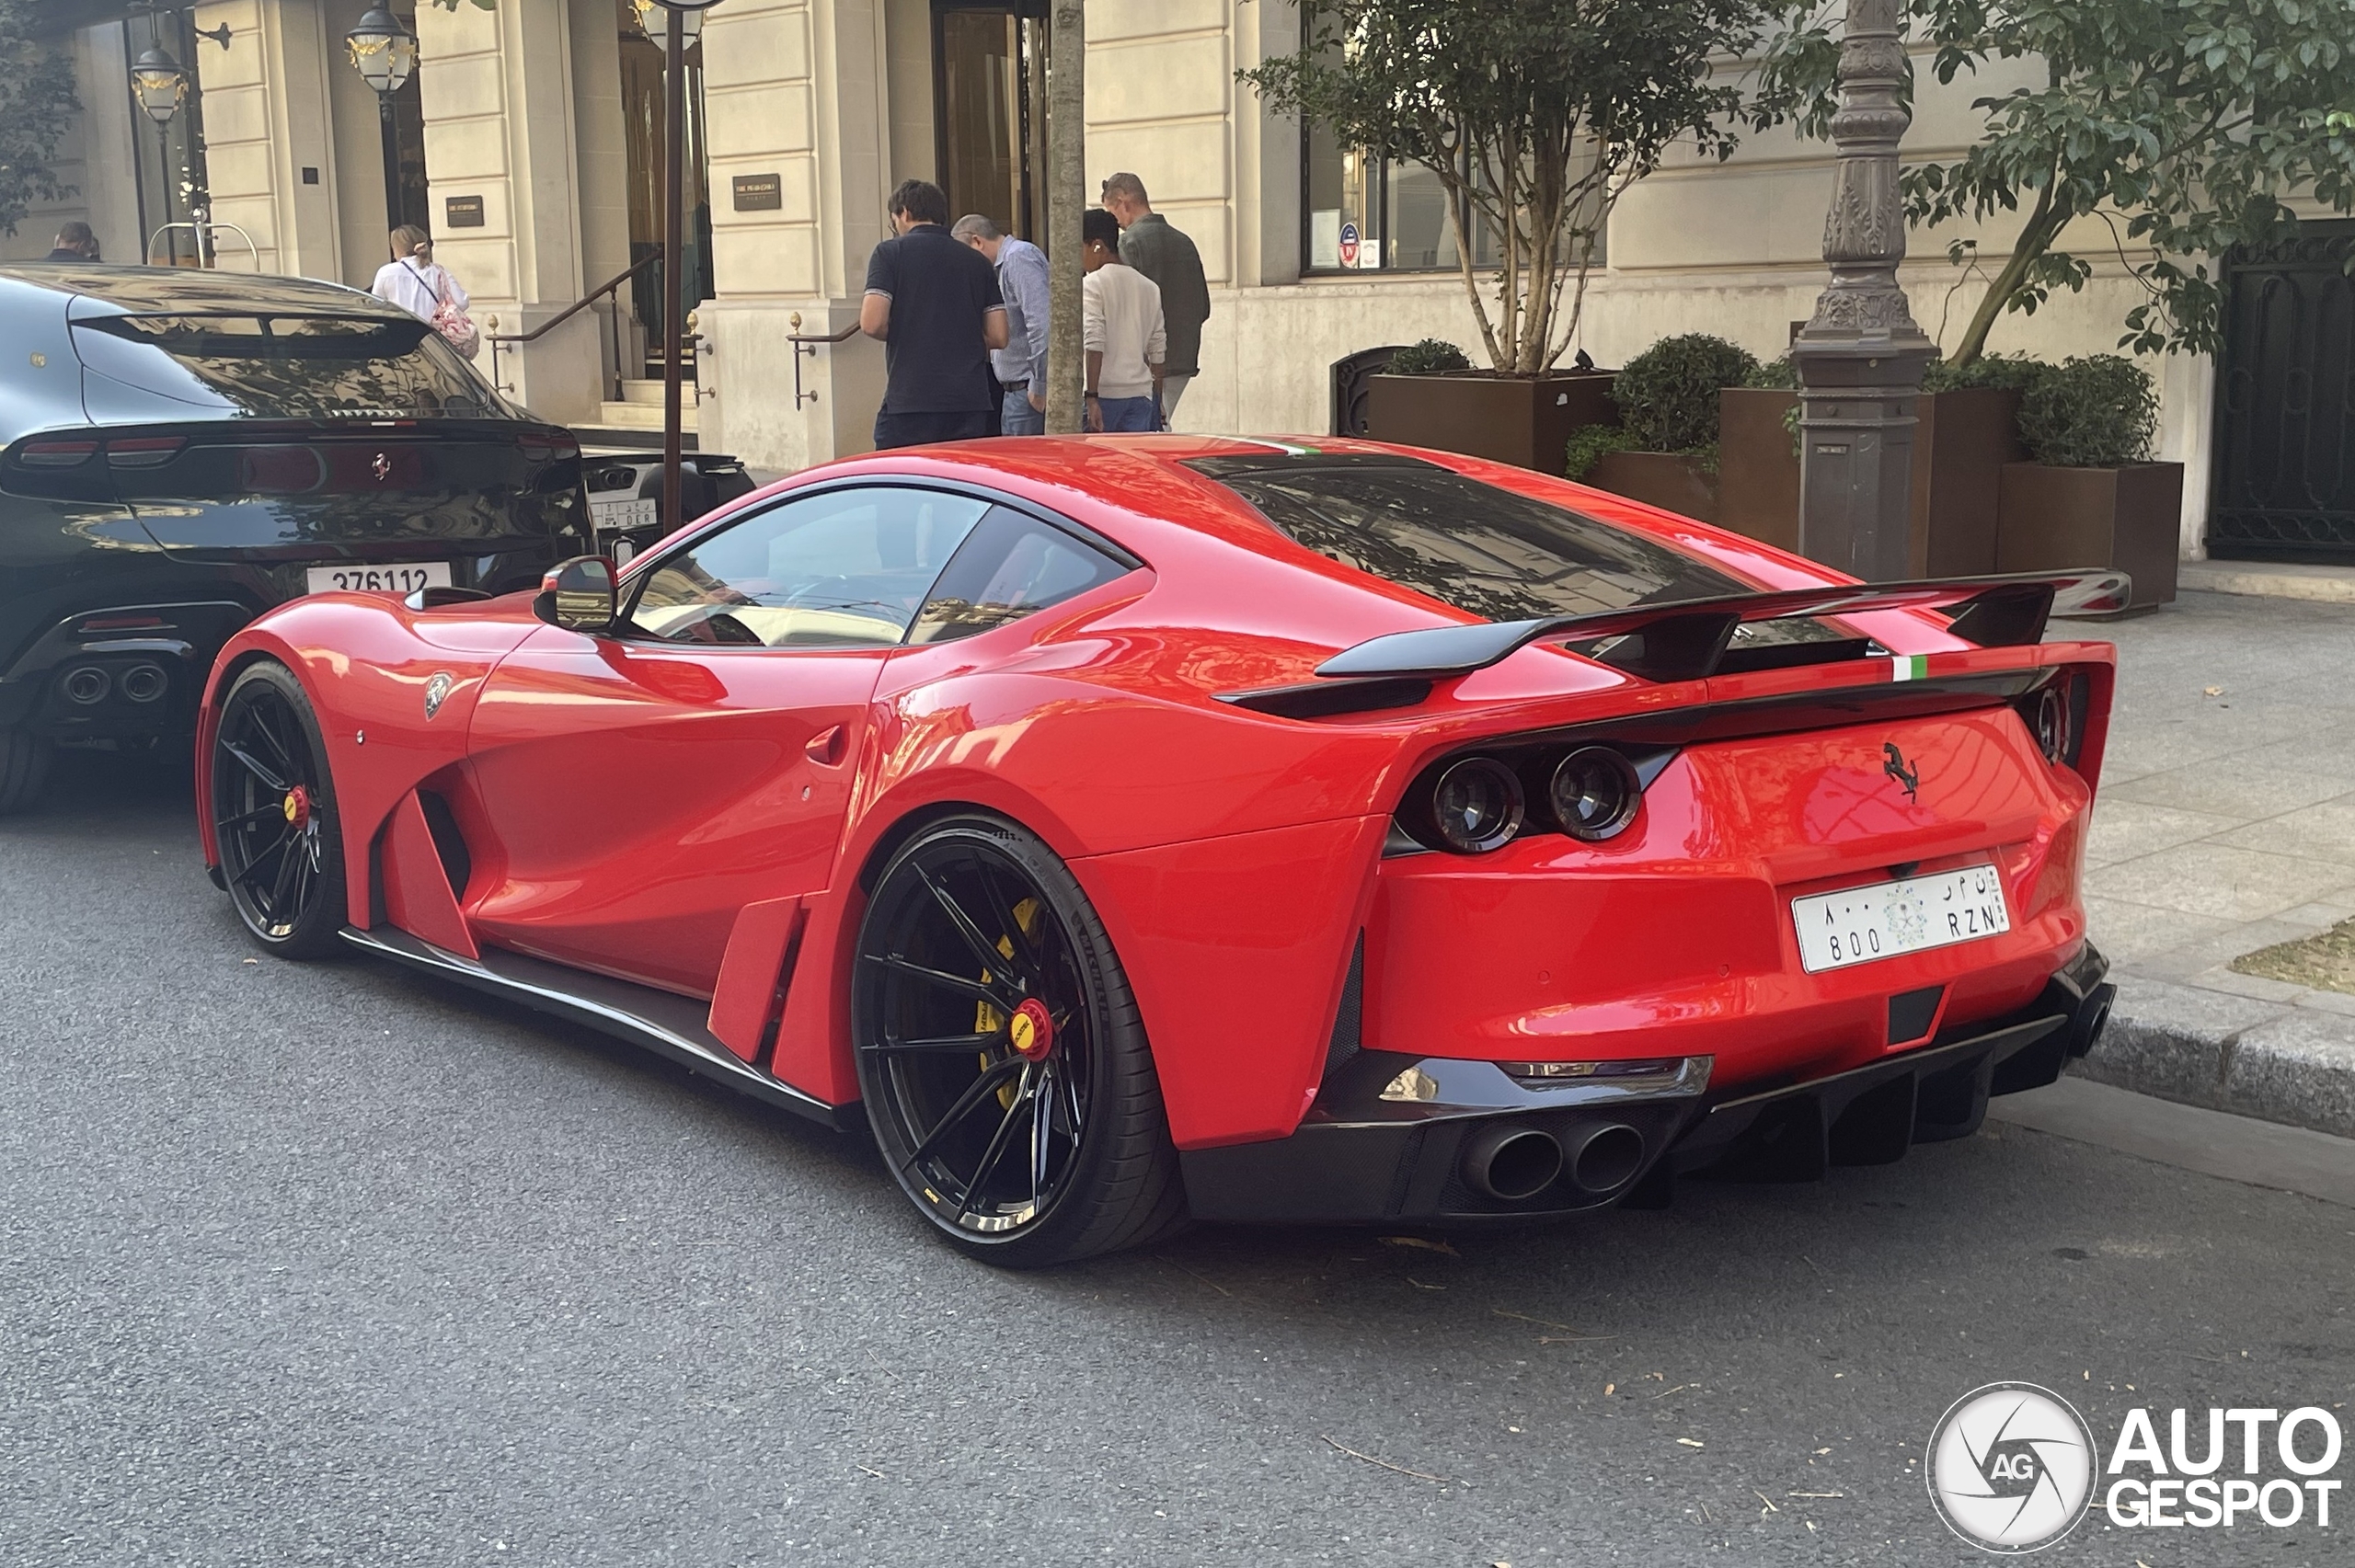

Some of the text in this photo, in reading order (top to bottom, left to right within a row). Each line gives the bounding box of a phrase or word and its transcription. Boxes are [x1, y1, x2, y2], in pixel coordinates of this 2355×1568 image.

[626, 513, 650, 525] DER
[333, 569, 428, 590] 376112
[1947, 905, 1995, 938] RZN
[1830, 928, 1880, 961] 800
